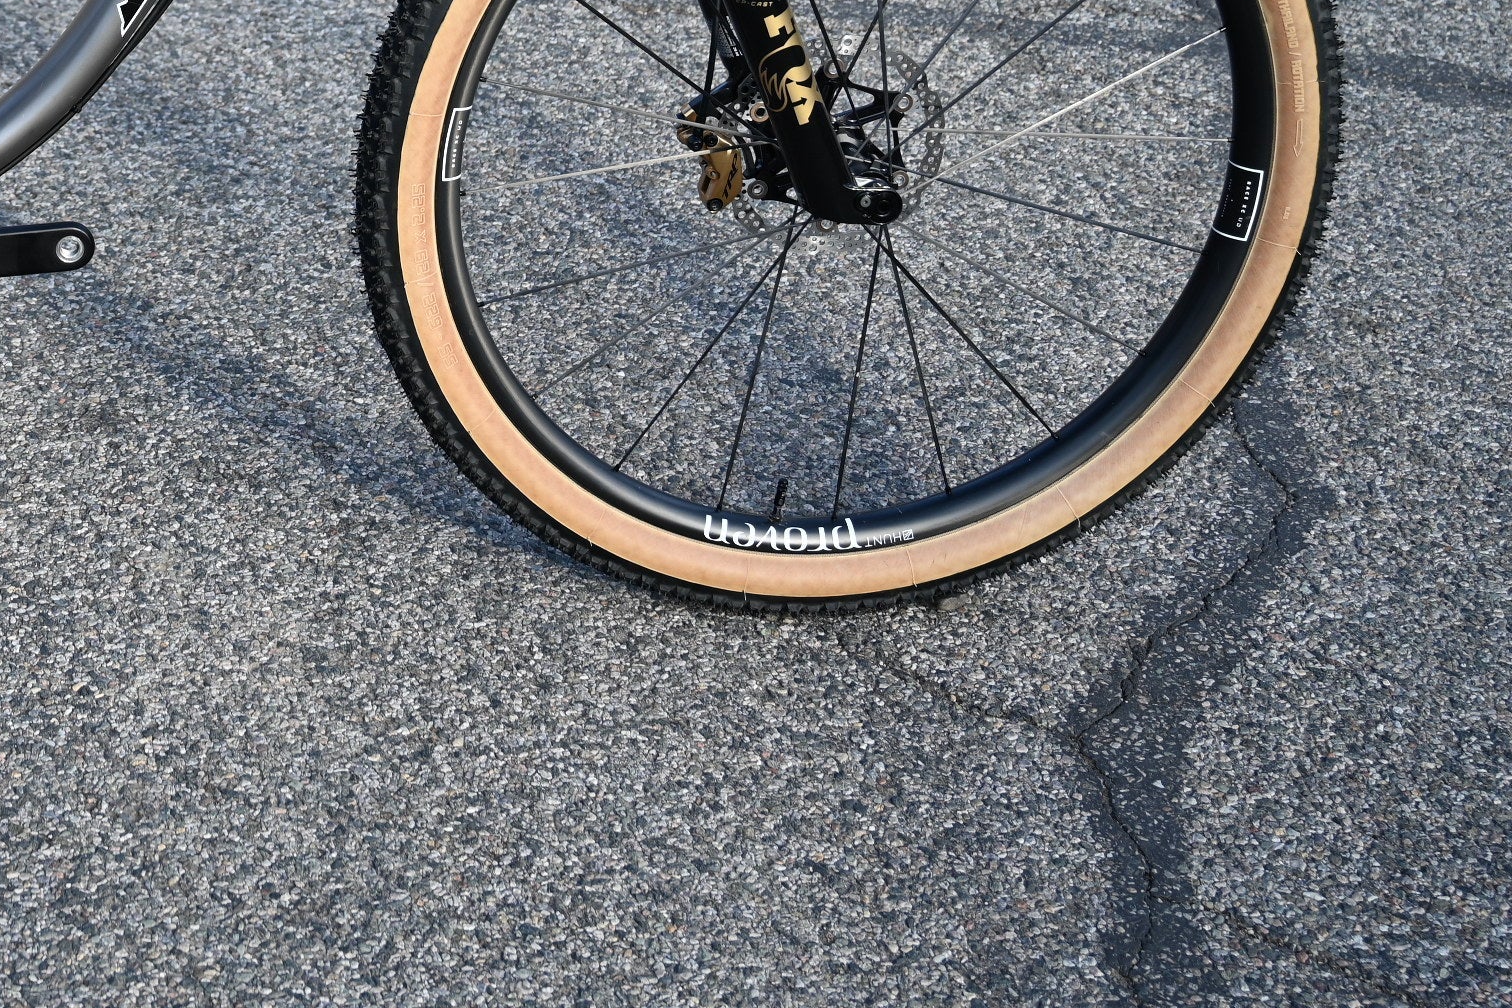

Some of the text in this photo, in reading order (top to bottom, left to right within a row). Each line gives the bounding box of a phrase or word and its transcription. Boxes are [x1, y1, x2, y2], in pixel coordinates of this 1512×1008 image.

[1293, 59, 1306, 113] ROTATION
[722, 151, 739, 199] TRP
[703, 514, 901, 552] HUNT proven
